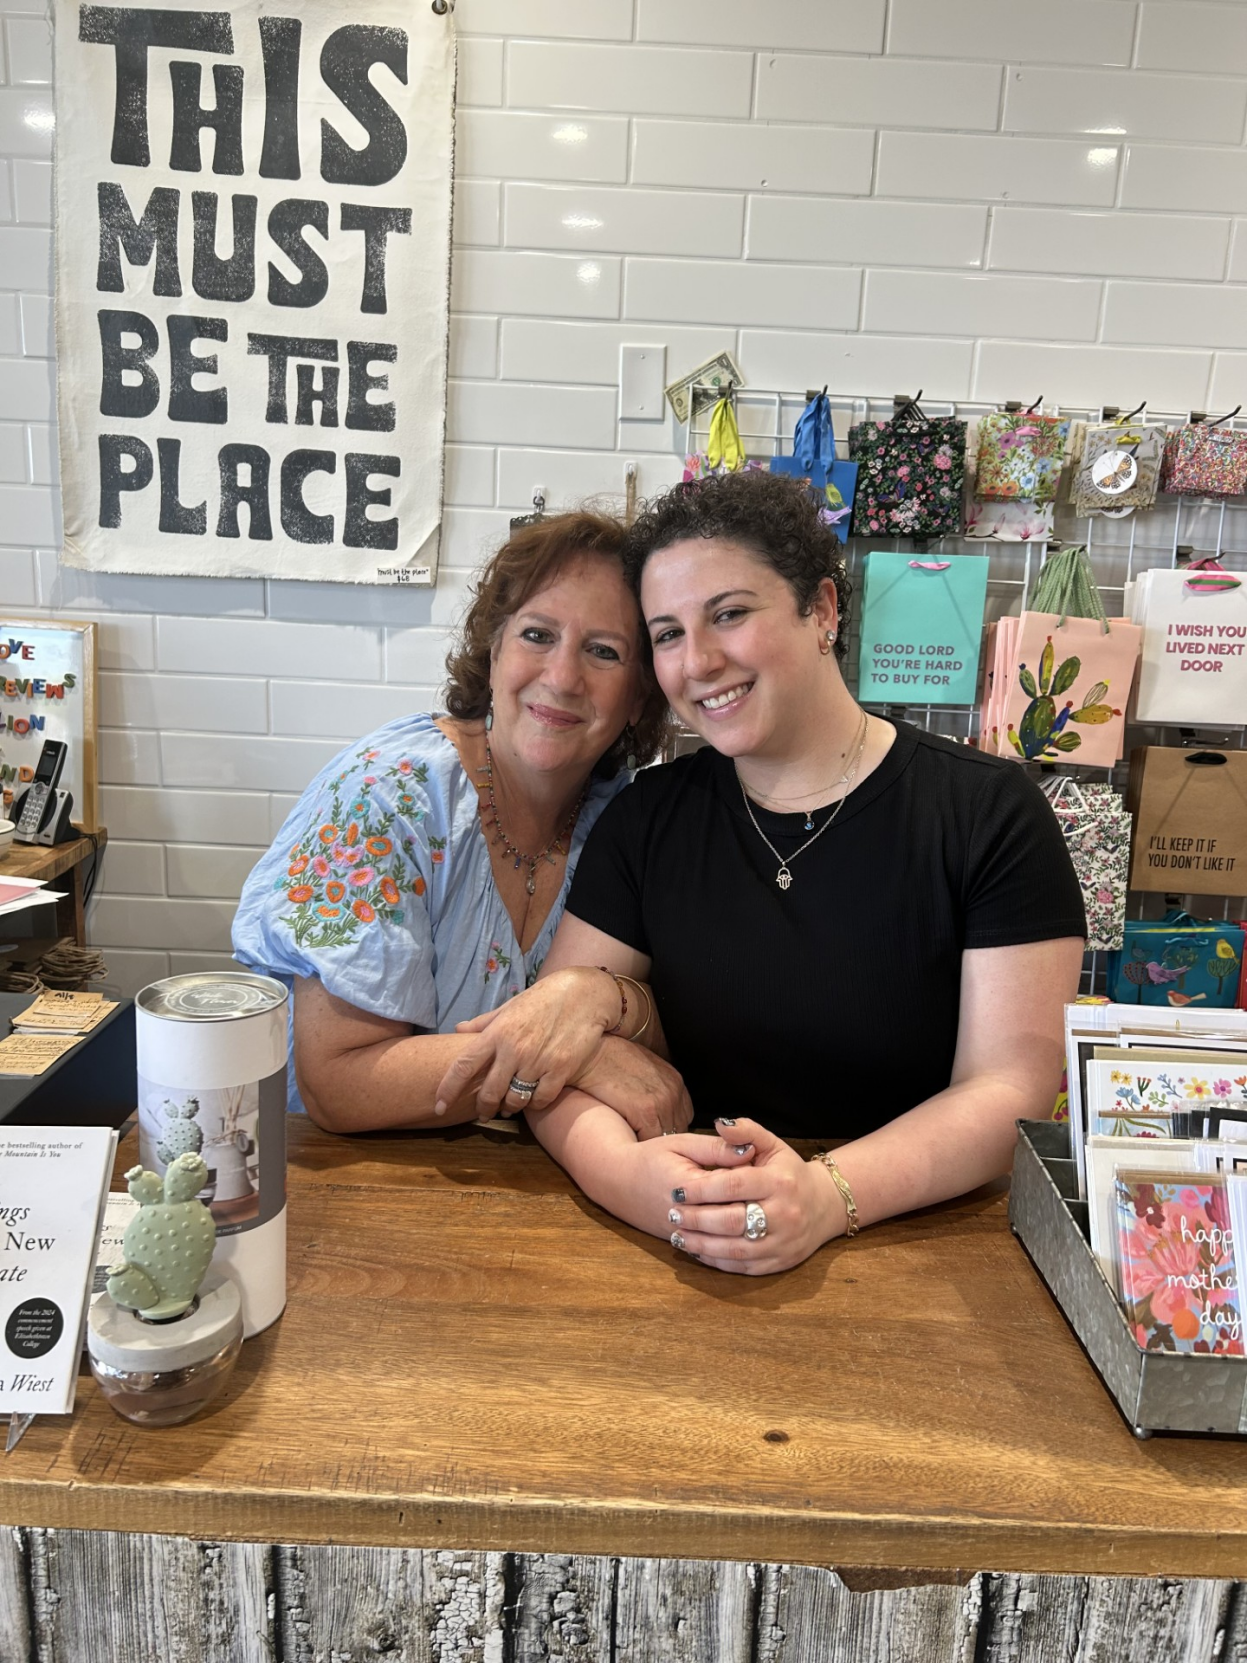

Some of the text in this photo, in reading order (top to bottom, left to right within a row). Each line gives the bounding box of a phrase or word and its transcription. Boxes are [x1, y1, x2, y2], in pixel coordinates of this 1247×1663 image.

[79, 4, 409, 186] THIS
[97, 182, 412, 314] MUST
[97, 309, 398, 432] BE THE
[98, 434, 401, 550] PLACE
[401, 568, 410, 576] the
[1168, 624, 1247, 638] I WISH YOU
[873, 643, 955, 656] GOOD LORD
[1166, 642, 1245, 655] LIVED NEXT
[872, 658, 963, 671] YOU'RE HARD
[1180, 659, 1223, 672] DOOR
[871, 673, 950, 685] TO BUY FOR
[1149, 835, 1217, 853] I'LL KEEP IT IF
[1148, 853, 1236, 871] YOU DON'T LIKE IT
[4, 1150, 38, 1158] Mountain
[7, 1141, 46, 1150] bestselling
[74, 1141, 84, 1149] of
[3, 1231, 56, 1251] New
[1181, 1215, 1234, 1257] happ
[1168, 1263, 1239, 1289] mothe
[1200, 1300, 1242, 1340] day
[10, 1374, 55, 1392] Wiest
